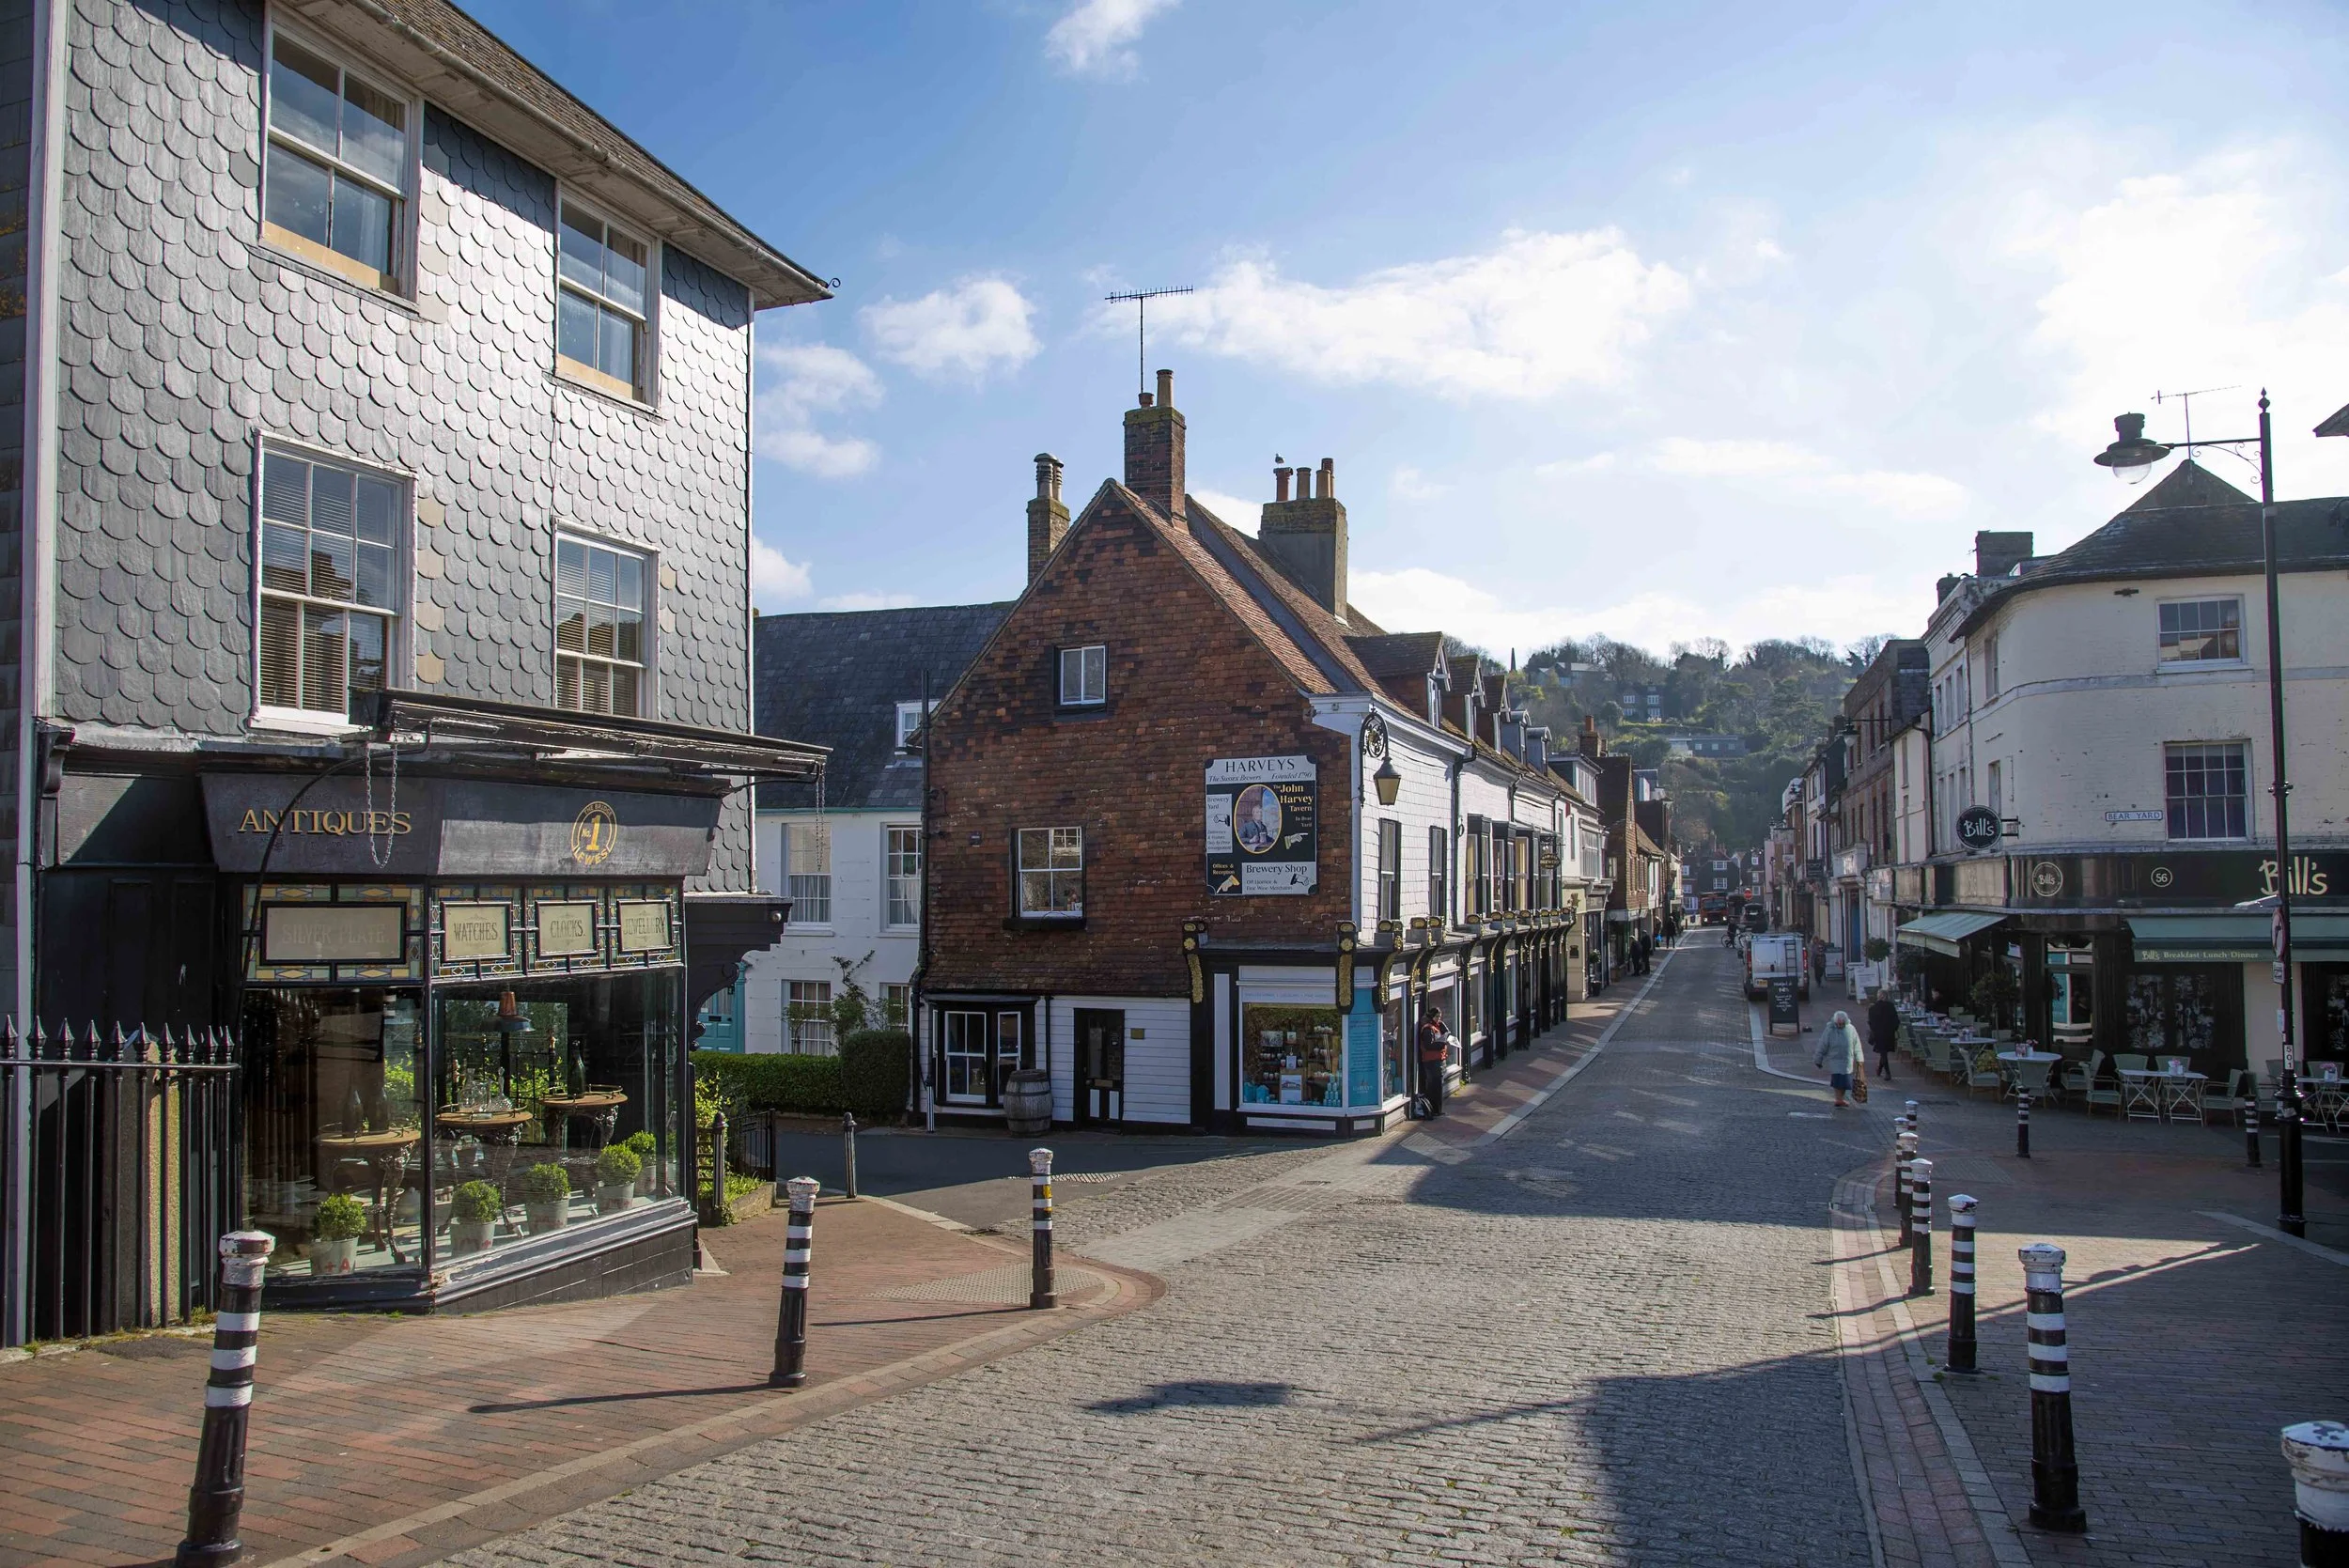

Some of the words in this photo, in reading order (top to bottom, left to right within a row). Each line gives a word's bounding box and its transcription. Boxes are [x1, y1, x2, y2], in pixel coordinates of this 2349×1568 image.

[1225, 759, 1295, 773] HARVEYS
[1280, 784, 1304, 793] John
[1280, 795, 1314, 805] Harvey
[238, 809, 412, 836] ANTIQUES
[1963, 817, 1994, 838] Bill's
[586, 815, 601, 851] 1
[1246, 864, 1283, 875] Brewery
[1284, 864, 1308, 875] Shop
[2258, 856, 2328, 895] Bill's
[2038, 873, 2056, 885] Bill's
[2155, 873, 2168, 883] 56
[282, 924, 332, 944] SILVER
[2141, 950, 2160, 960] Bill's
